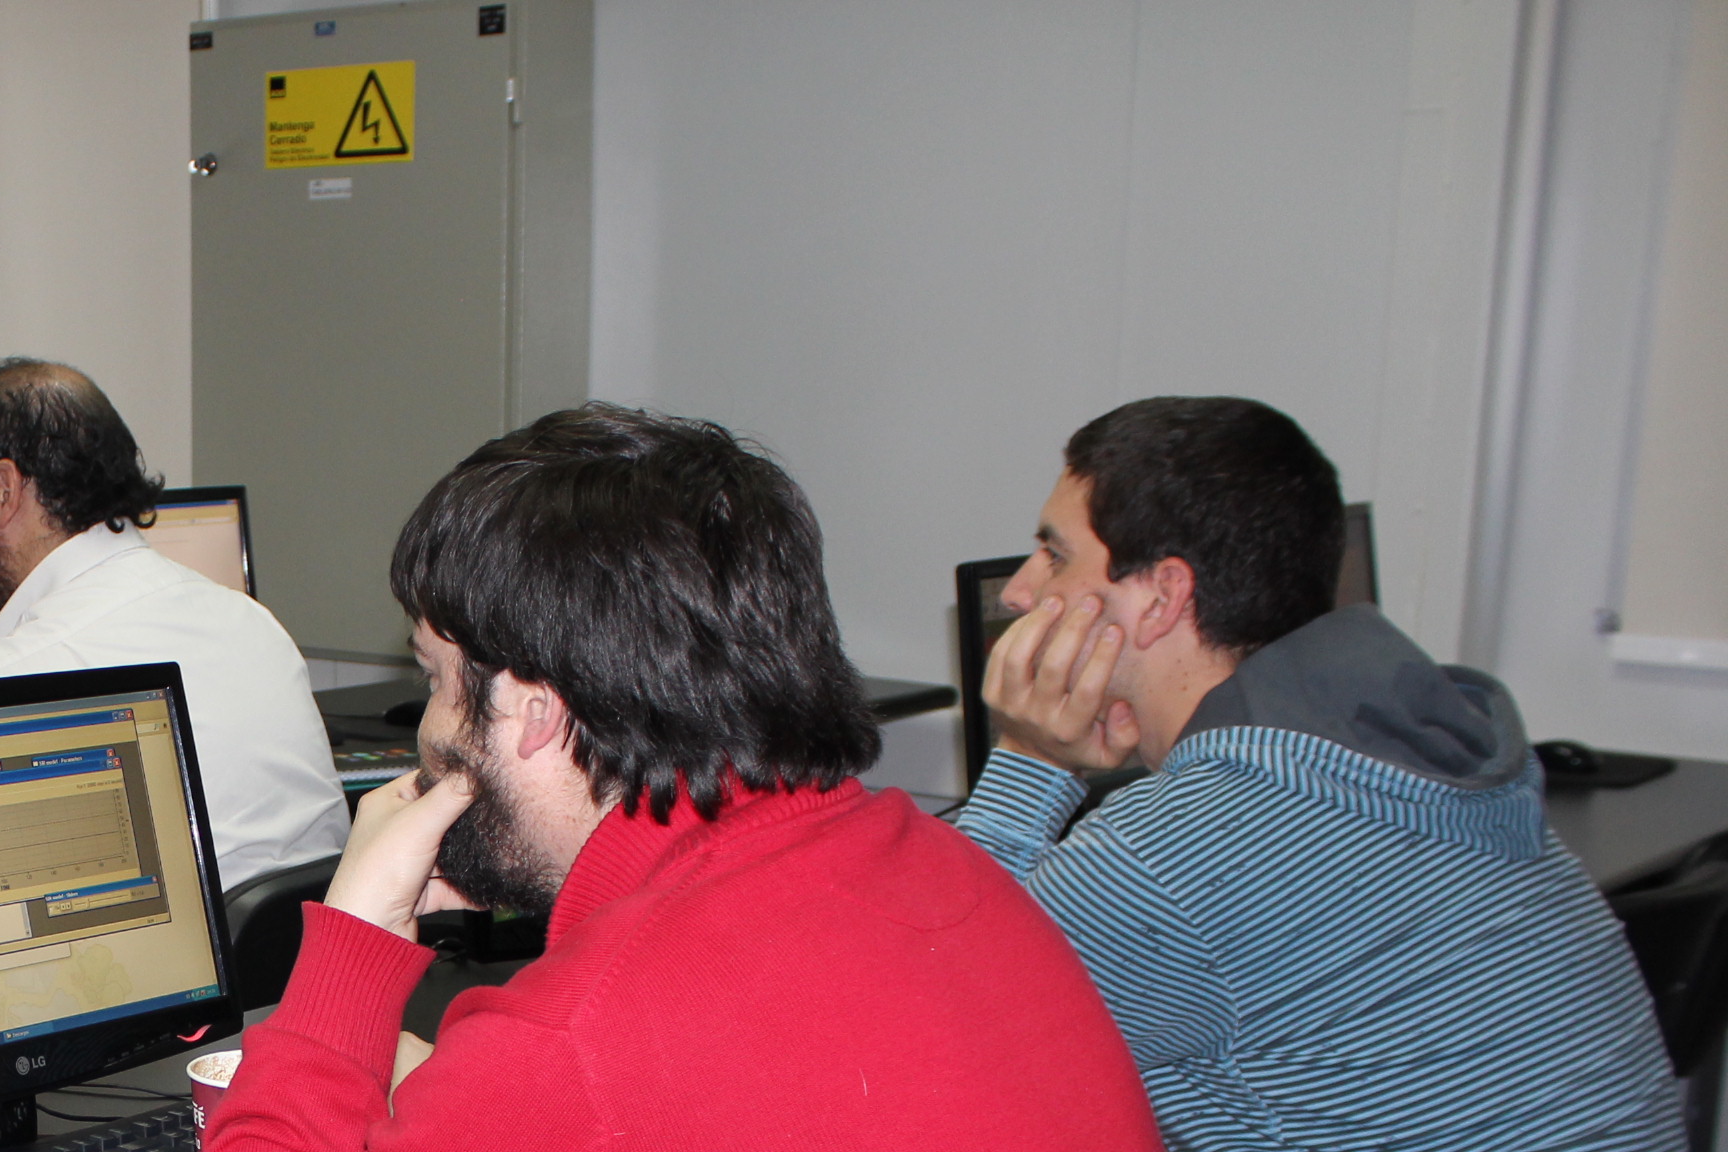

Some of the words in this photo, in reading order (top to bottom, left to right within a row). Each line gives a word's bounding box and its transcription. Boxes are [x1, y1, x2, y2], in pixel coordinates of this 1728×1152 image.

[270, 121, 315, 132] Mantenga
[270, 134, 307, 144] Cerrado
[60, 756, 83, 764] Parameters
[30, 1055, 47, 1069] LG
